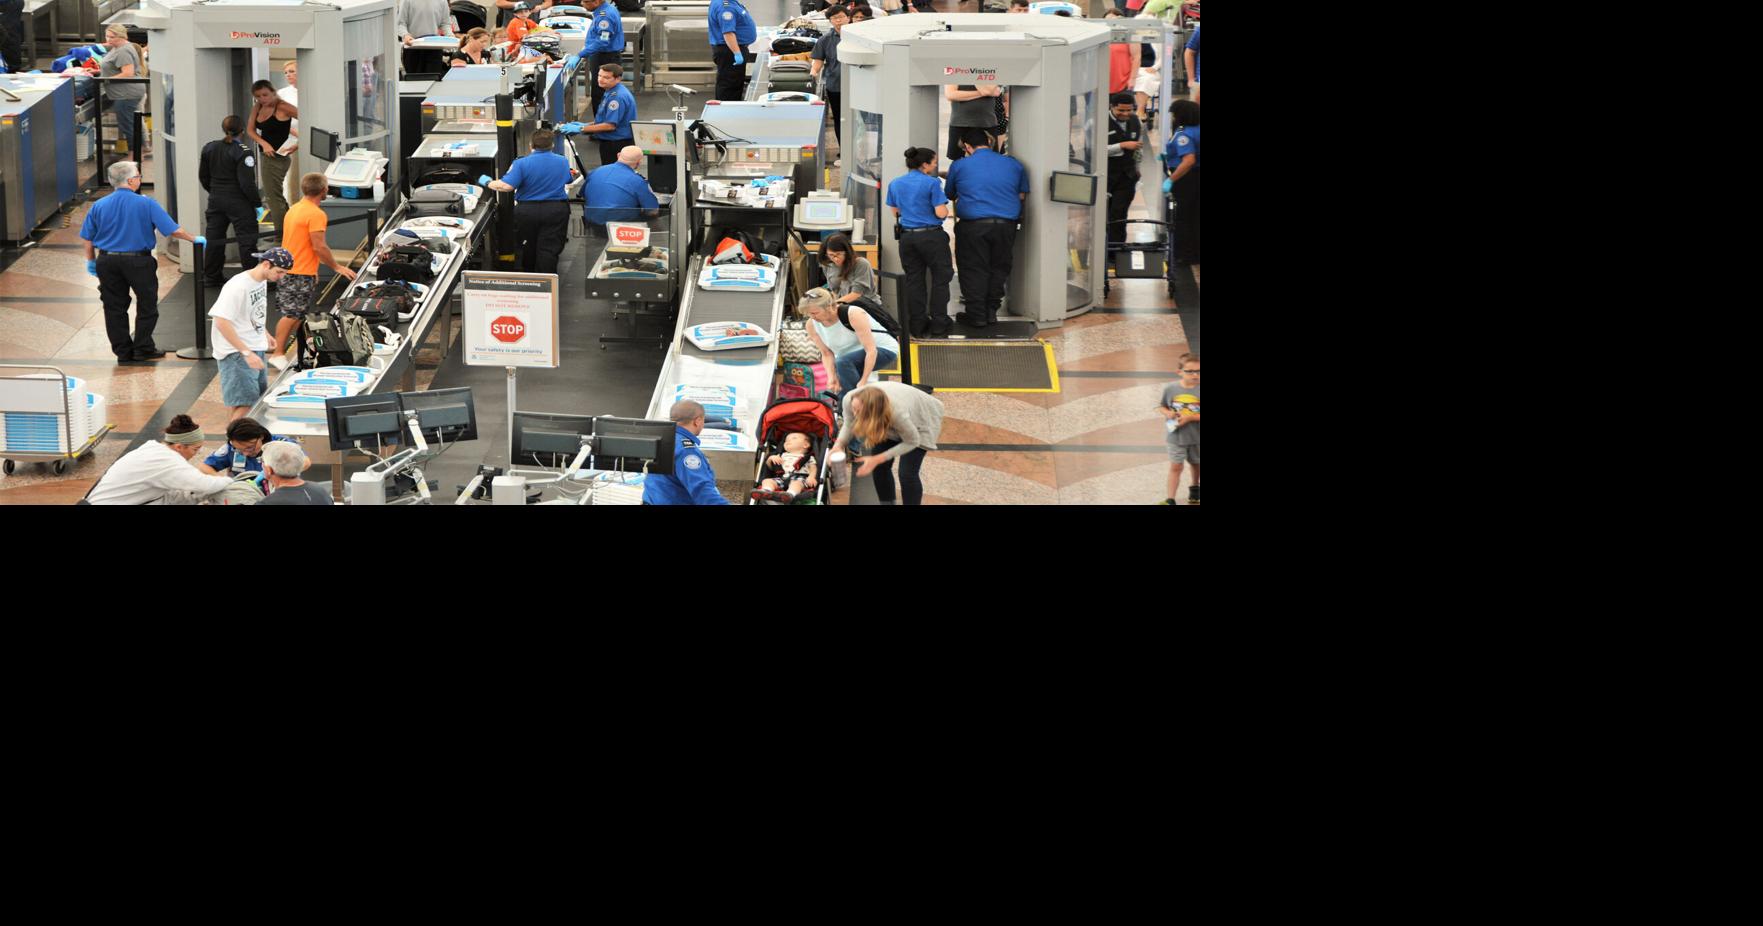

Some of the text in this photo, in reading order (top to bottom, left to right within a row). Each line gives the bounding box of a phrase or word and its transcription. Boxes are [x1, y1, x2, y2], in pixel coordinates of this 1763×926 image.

[501, 67, 506, 75] 5
[677, 112, 682, 121] 6
[492, 324, 524, 335] STOP
